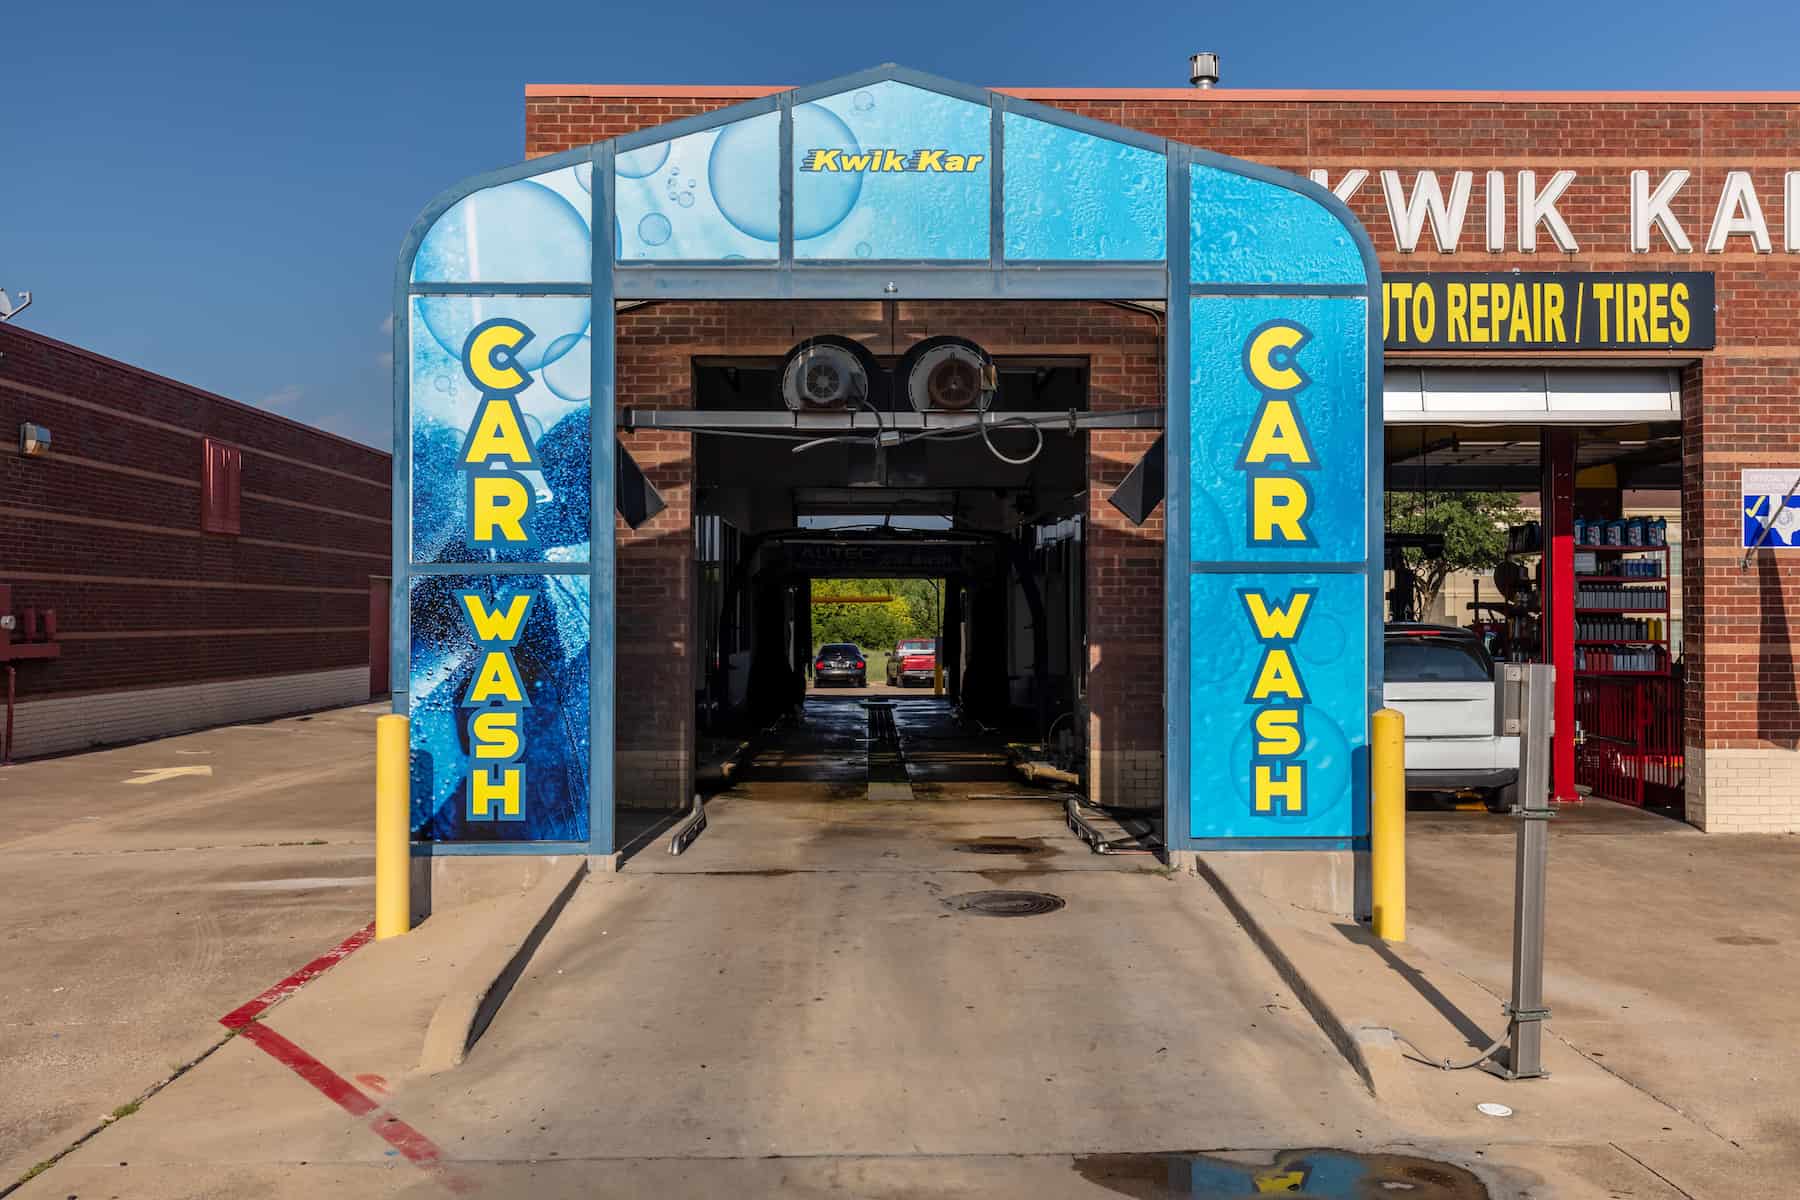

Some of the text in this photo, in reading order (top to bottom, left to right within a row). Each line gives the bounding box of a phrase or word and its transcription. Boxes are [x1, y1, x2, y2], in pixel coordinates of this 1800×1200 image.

[802, 149, 984, 172] Kwik Kar
[1447, 282, 1564, 343] REPAIR
[1575, 282, 1585, 344] /
[1592, 282, 1691, 344] TIRES
[462, 322, 533, 818] CAR WASH
[1243, 323, 1313, 813] CAR WASH
